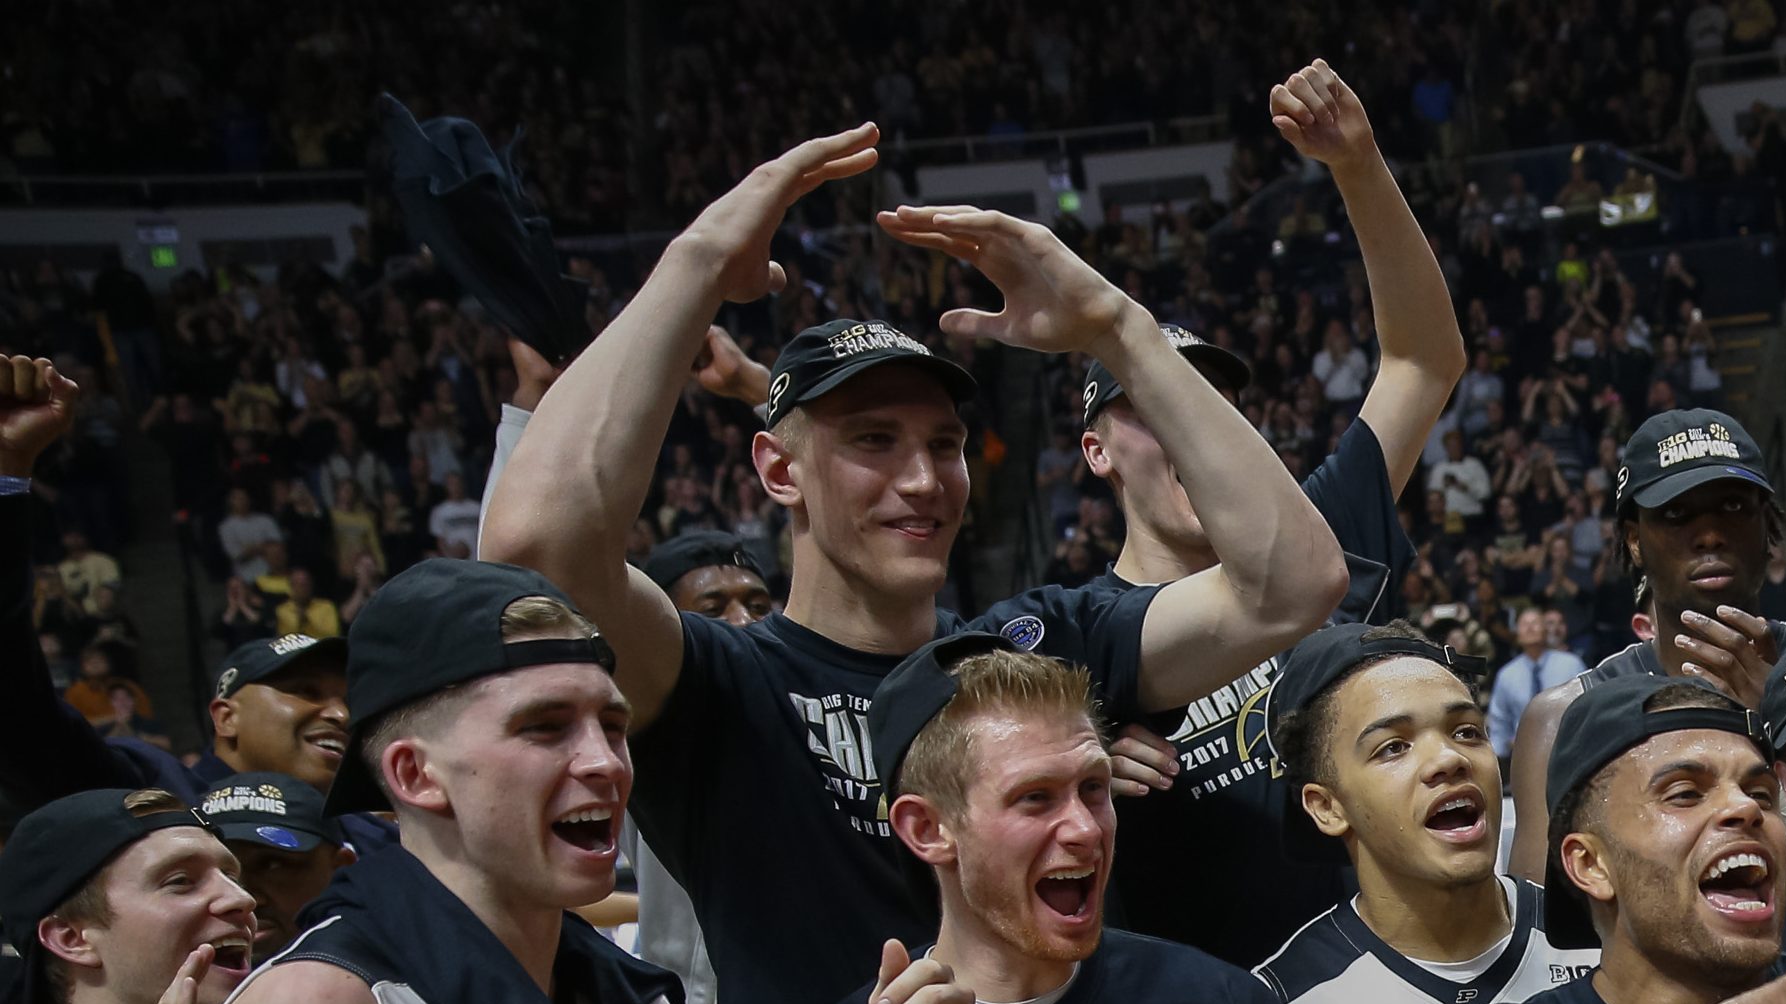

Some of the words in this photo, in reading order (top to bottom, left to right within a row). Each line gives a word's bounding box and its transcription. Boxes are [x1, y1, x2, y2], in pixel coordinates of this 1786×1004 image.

[1660, 440, 1740, 468] CHAMPIONS
[821, 693, 842, 710] BIG
[1180, 736, 1230, 771] 2017
[1190, 756, 1267, 800] PURDUE
[202, 796, 286, 815] CHAMPIONS
[1455, 988, 1479, 1004] P
